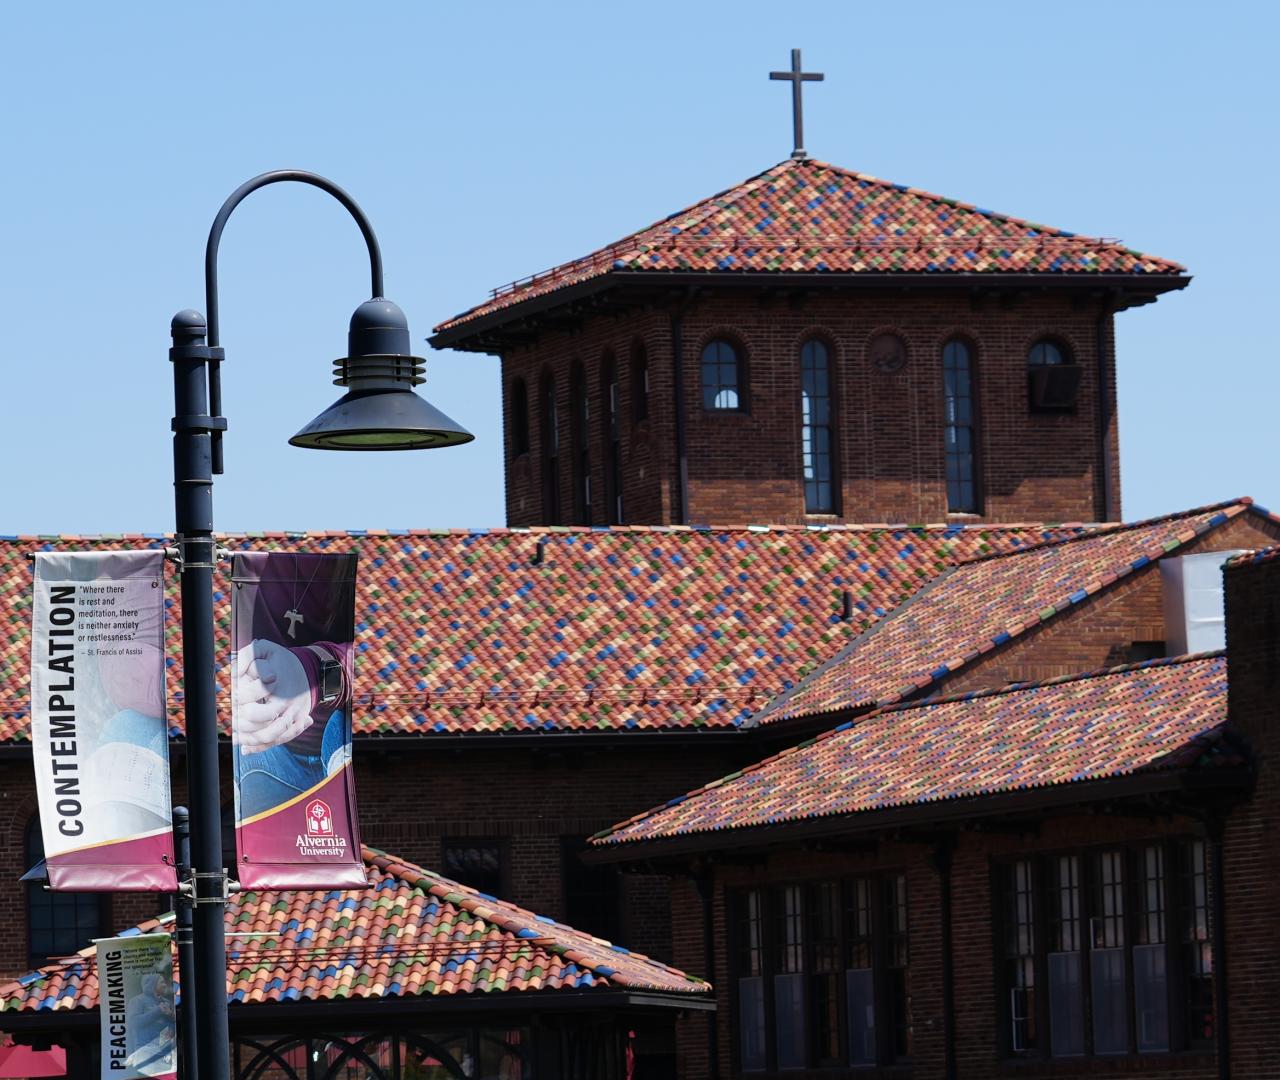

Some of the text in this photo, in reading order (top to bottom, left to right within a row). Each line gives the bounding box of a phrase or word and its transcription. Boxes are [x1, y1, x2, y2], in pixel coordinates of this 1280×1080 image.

[80, 585, 125, 594] "Where there
[78, 609, 138, 618] meditation, there
[113, 621, 139, 630] anxiety
[48, 586, 84, 837] CONTEMPLATION
[296, 834, 347, 847] Alvernia
[300, 847, 345, 857] University
[106, 950, 127, 1070] PEACEMAKING
